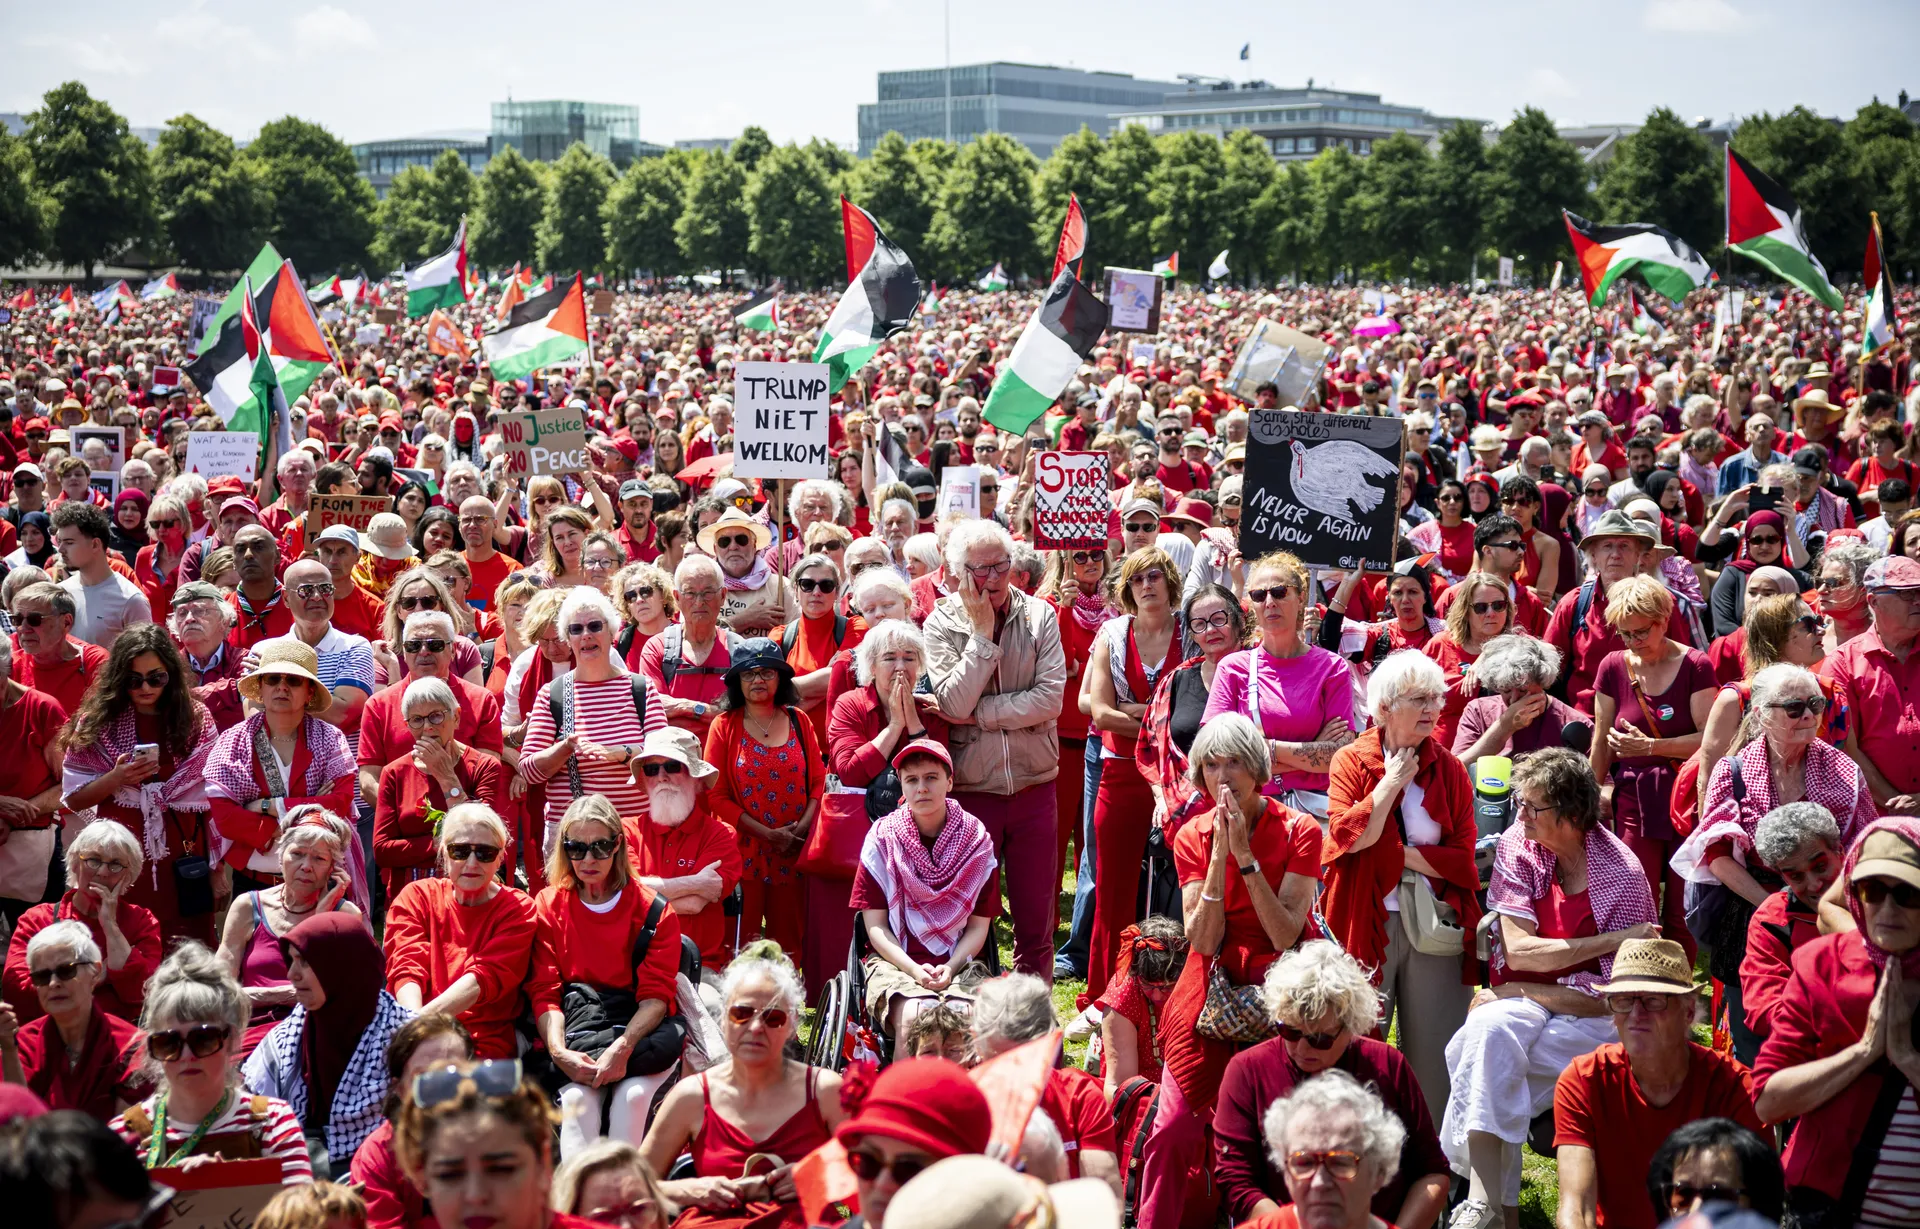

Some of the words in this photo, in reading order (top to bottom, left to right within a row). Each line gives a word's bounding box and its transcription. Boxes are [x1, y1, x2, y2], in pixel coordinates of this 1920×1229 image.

[743, 377, 827, 401] TRUMP
[1254, 409, 1289, 423] Same
[1323, 415, 1372, 430] different
[1260, 419, 1330, 438] assholes
[193, 435, 215, 444] WAT
[220, 435, 236, 444] ALS
[502, 421, 522, 444] NO
[523, 414, 581, 446] Justice
[506, 449, 526, 474] NO
[530, 447, 587, 474] PEACE
[740, 441, 827, 465] WELKOM
[1040, 452, 1102, 493] STOP
[311, 497, 353, 512] FROM
[360, 500, 386, 512] THE
[1066, 495, 1093, 507] THE
[1250, 487, 1309, 525] NEVER
[321, 510, 371, 530] RIVER
[1040, 510, 1107, 524] GENOCIDE
[308, 531, 320, 544] T
[1035, 536, 1061, 548] FREE
[1269, 521, 1313, 545] NOW
[728, 598, 746, 608] Van
